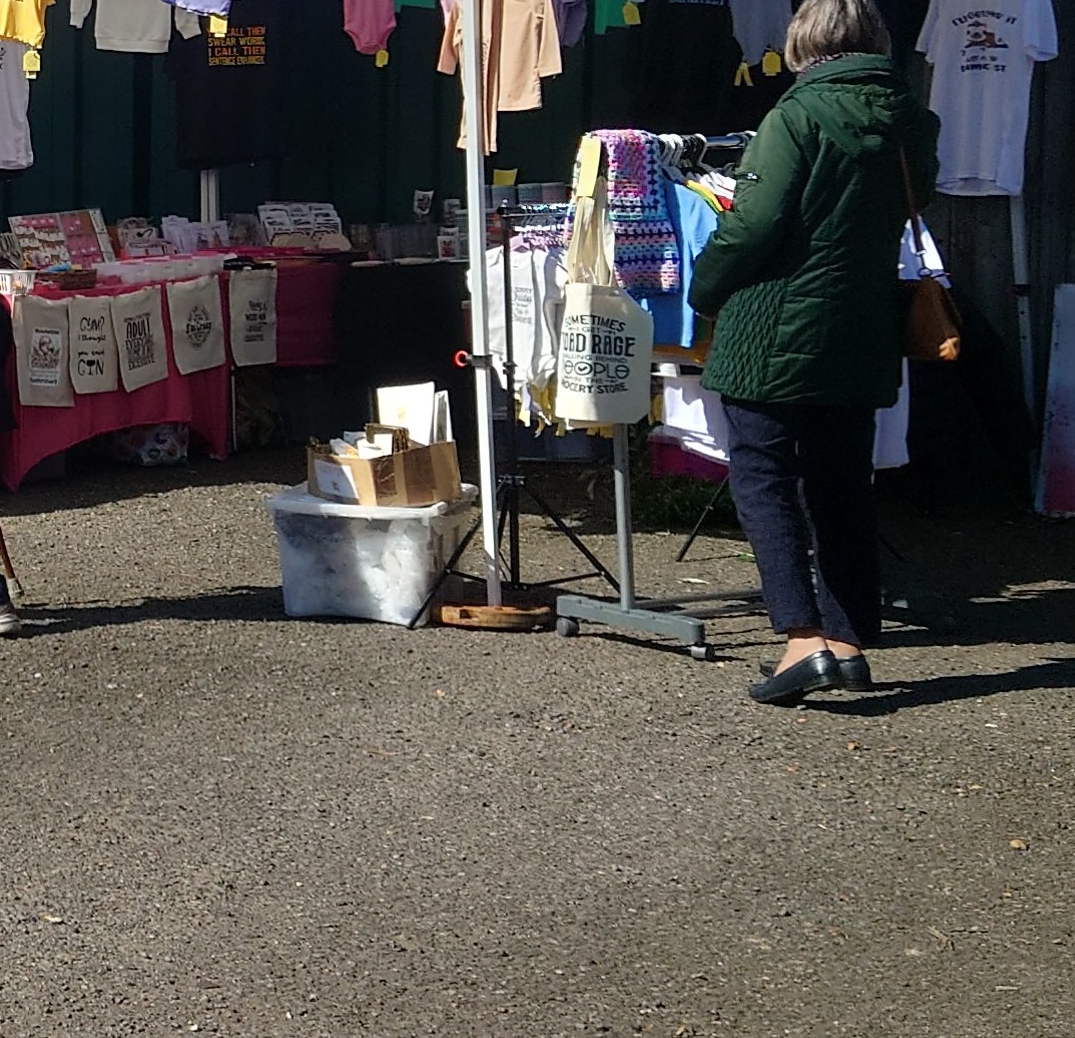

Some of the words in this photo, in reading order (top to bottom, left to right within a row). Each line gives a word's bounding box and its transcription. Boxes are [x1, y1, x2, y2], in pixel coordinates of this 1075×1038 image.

[207, 37, 237, 47] SWEAR
[214, 46, 239, 56] CALL
[565, 314, 626, 333] SOMETIMES
[562, 331, 587, 353] OAD
[591, 333, 636, 358] RAGE
[77, 358, 104, 377] GIN
[564, 359, 630, 380] EOPLE
[584, 376, 604, 384] THE
[596, 382, 629, 394] STORE
